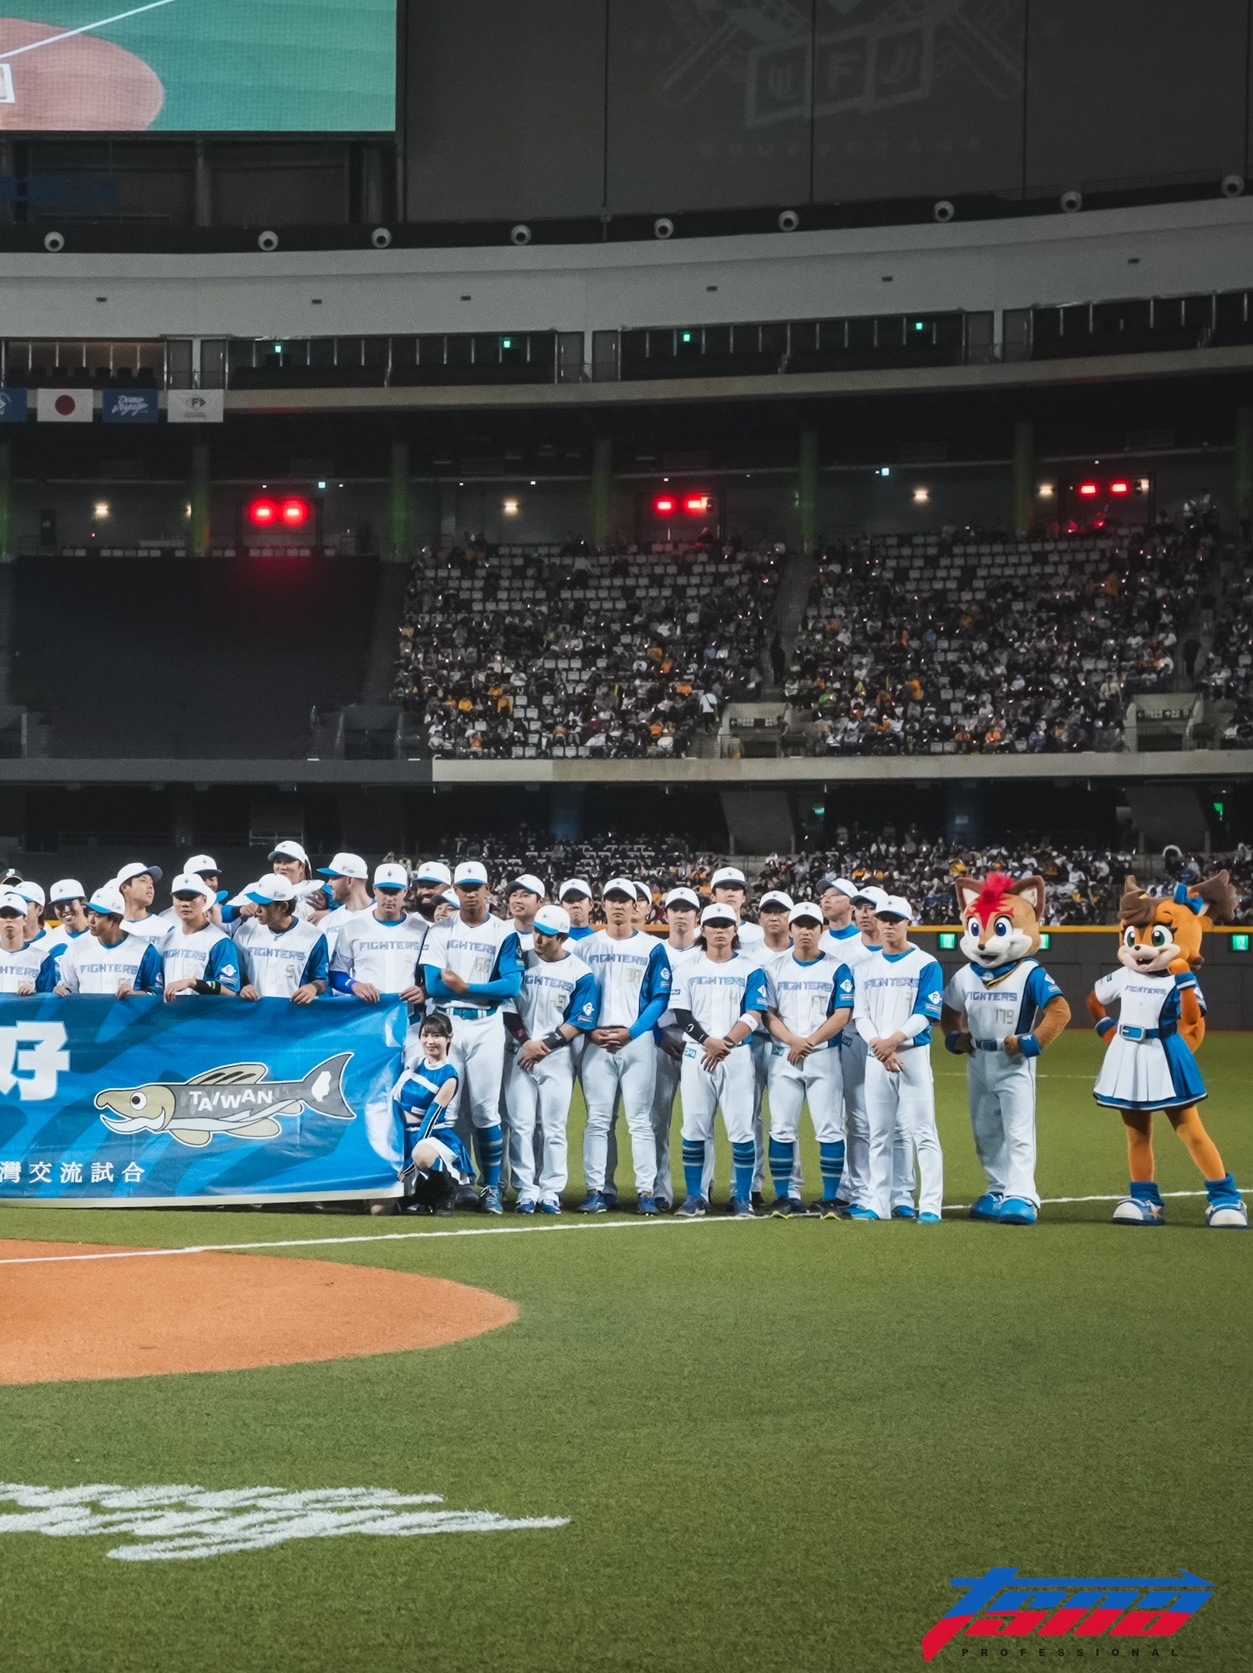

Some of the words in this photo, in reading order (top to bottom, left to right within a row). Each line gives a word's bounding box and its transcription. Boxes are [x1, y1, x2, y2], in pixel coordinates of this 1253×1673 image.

[1125, 985, 1167, 995] FIGHTERS
[966, 991, 1018, 1001] FIGHTERS
[189, 1088, 273, 1112] TAIWAN
